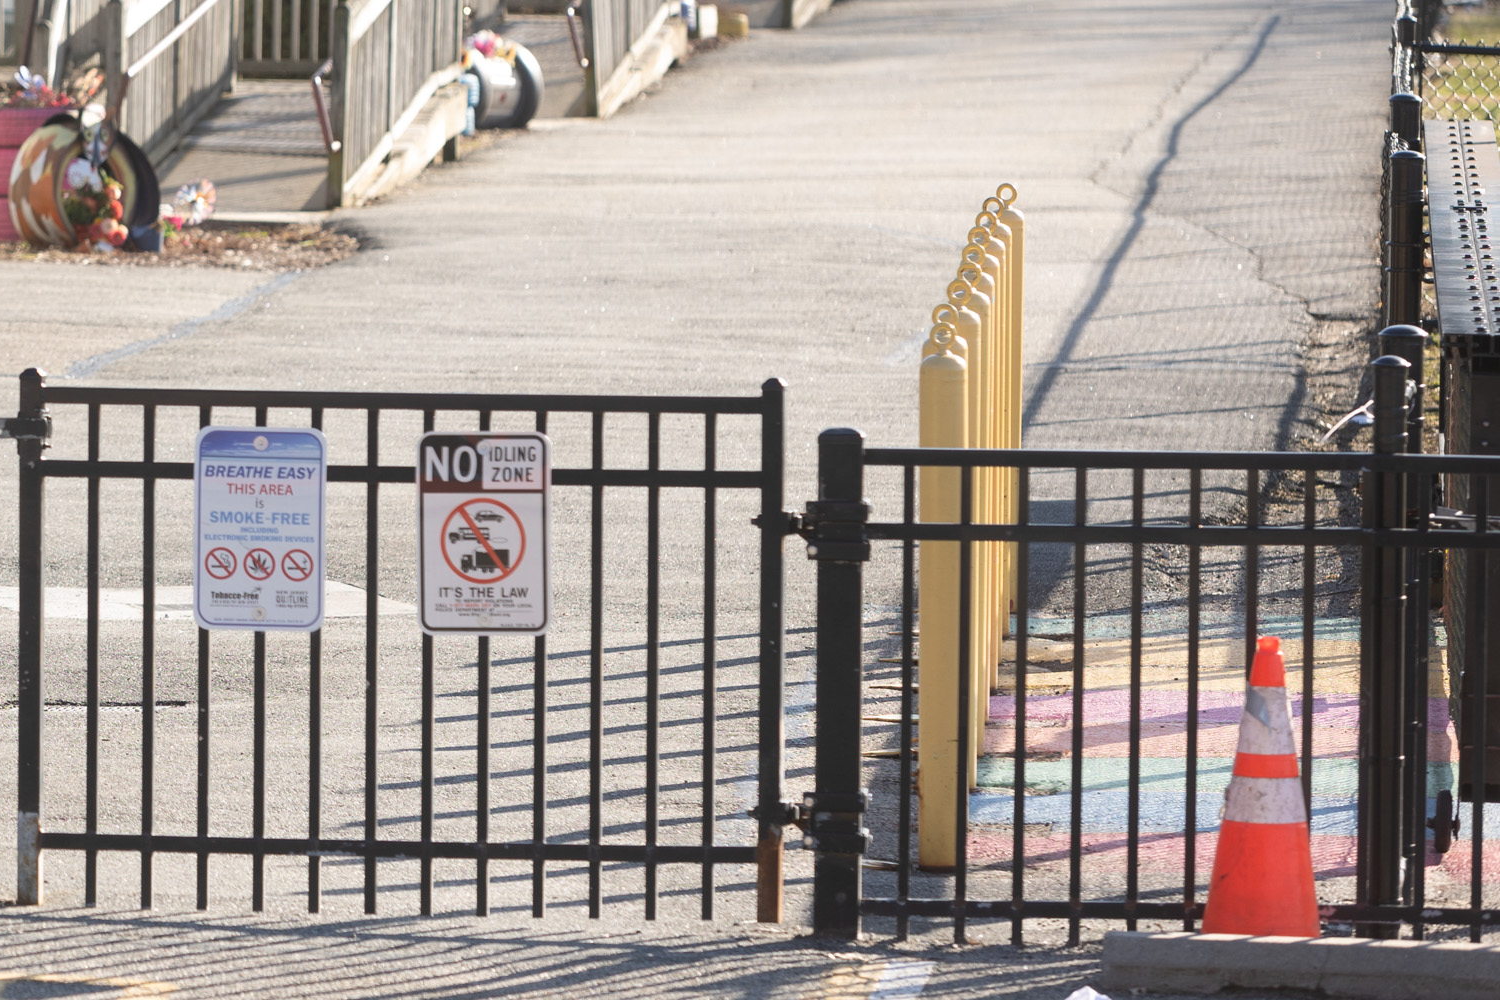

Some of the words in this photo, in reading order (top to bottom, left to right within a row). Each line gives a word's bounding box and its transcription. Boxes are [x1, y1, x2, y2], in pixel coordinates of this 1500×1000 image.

[425, 445, 478, 483] NO
[489, 446, 537, 462] IDLING
[204, 465, 274, 479] BREATHE
[277, 466, 316, 480] EASY
[491, 467, 534, 483] ZONE
[227, 483, 256, 495] THIS
[259, 484, 294, 496] AREA
[255, 497, 264, 509] is
[209, 511, 310, 526] SMOKE-FREE
[204, 533, 248, 541] ELECTRONIC
[250, 534, 283, 542] SMOKING
[284, 535, 315, 543] DEVICES
[439, 587, 463, 598] IT'S
[469, 587, 495, 598] THE
[501, 587, 529, 598] LAW
